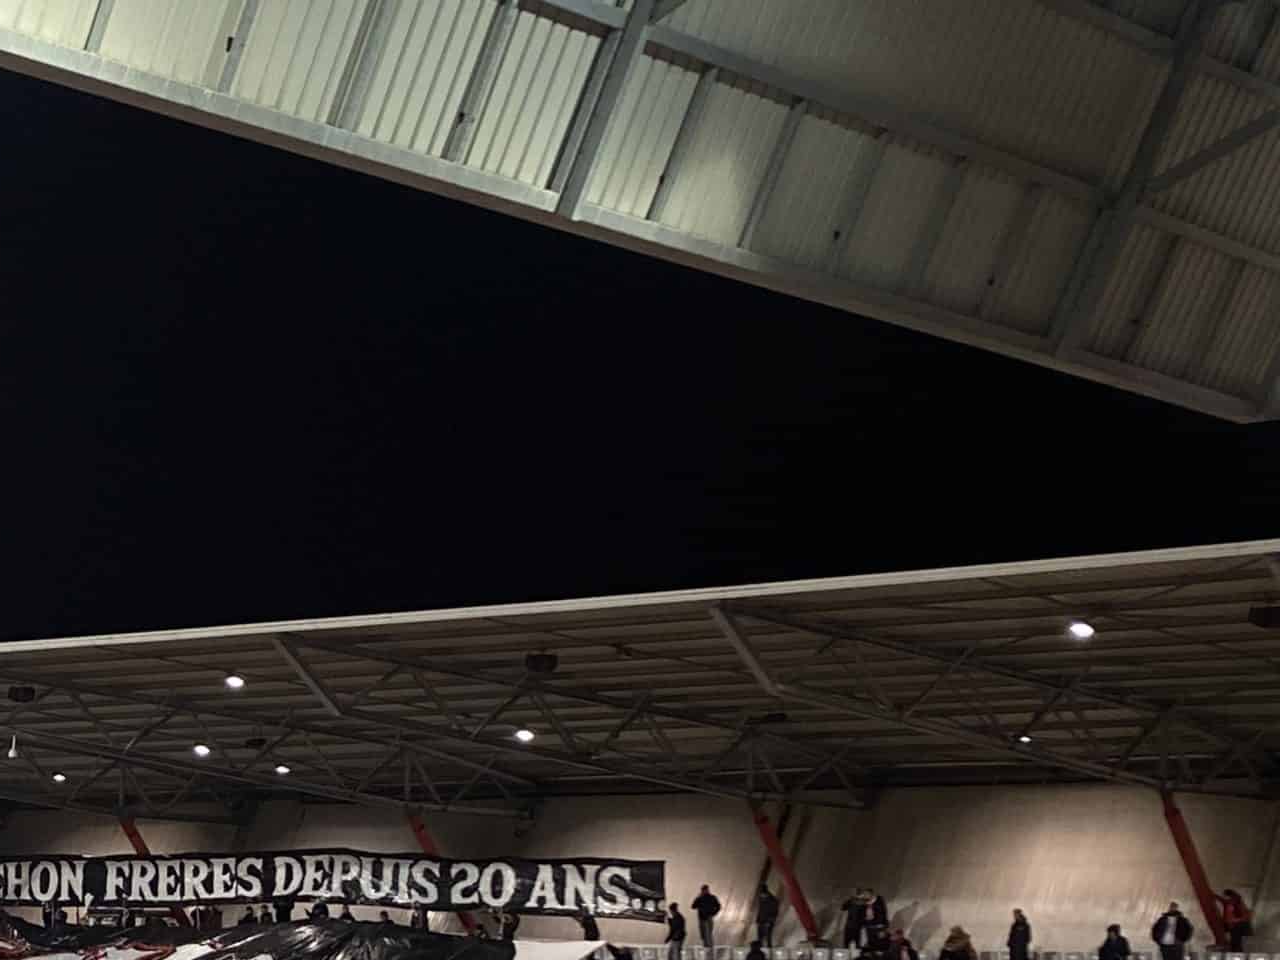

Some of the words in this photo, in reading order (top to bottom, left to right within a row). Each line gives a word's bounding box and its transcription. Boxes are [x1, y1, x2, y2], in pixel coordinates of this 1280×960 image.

[103, 856, 264, 901] FRERES
[271, 854, 440, 905] DEPUIS
[450, 861, 516, 907] 20
